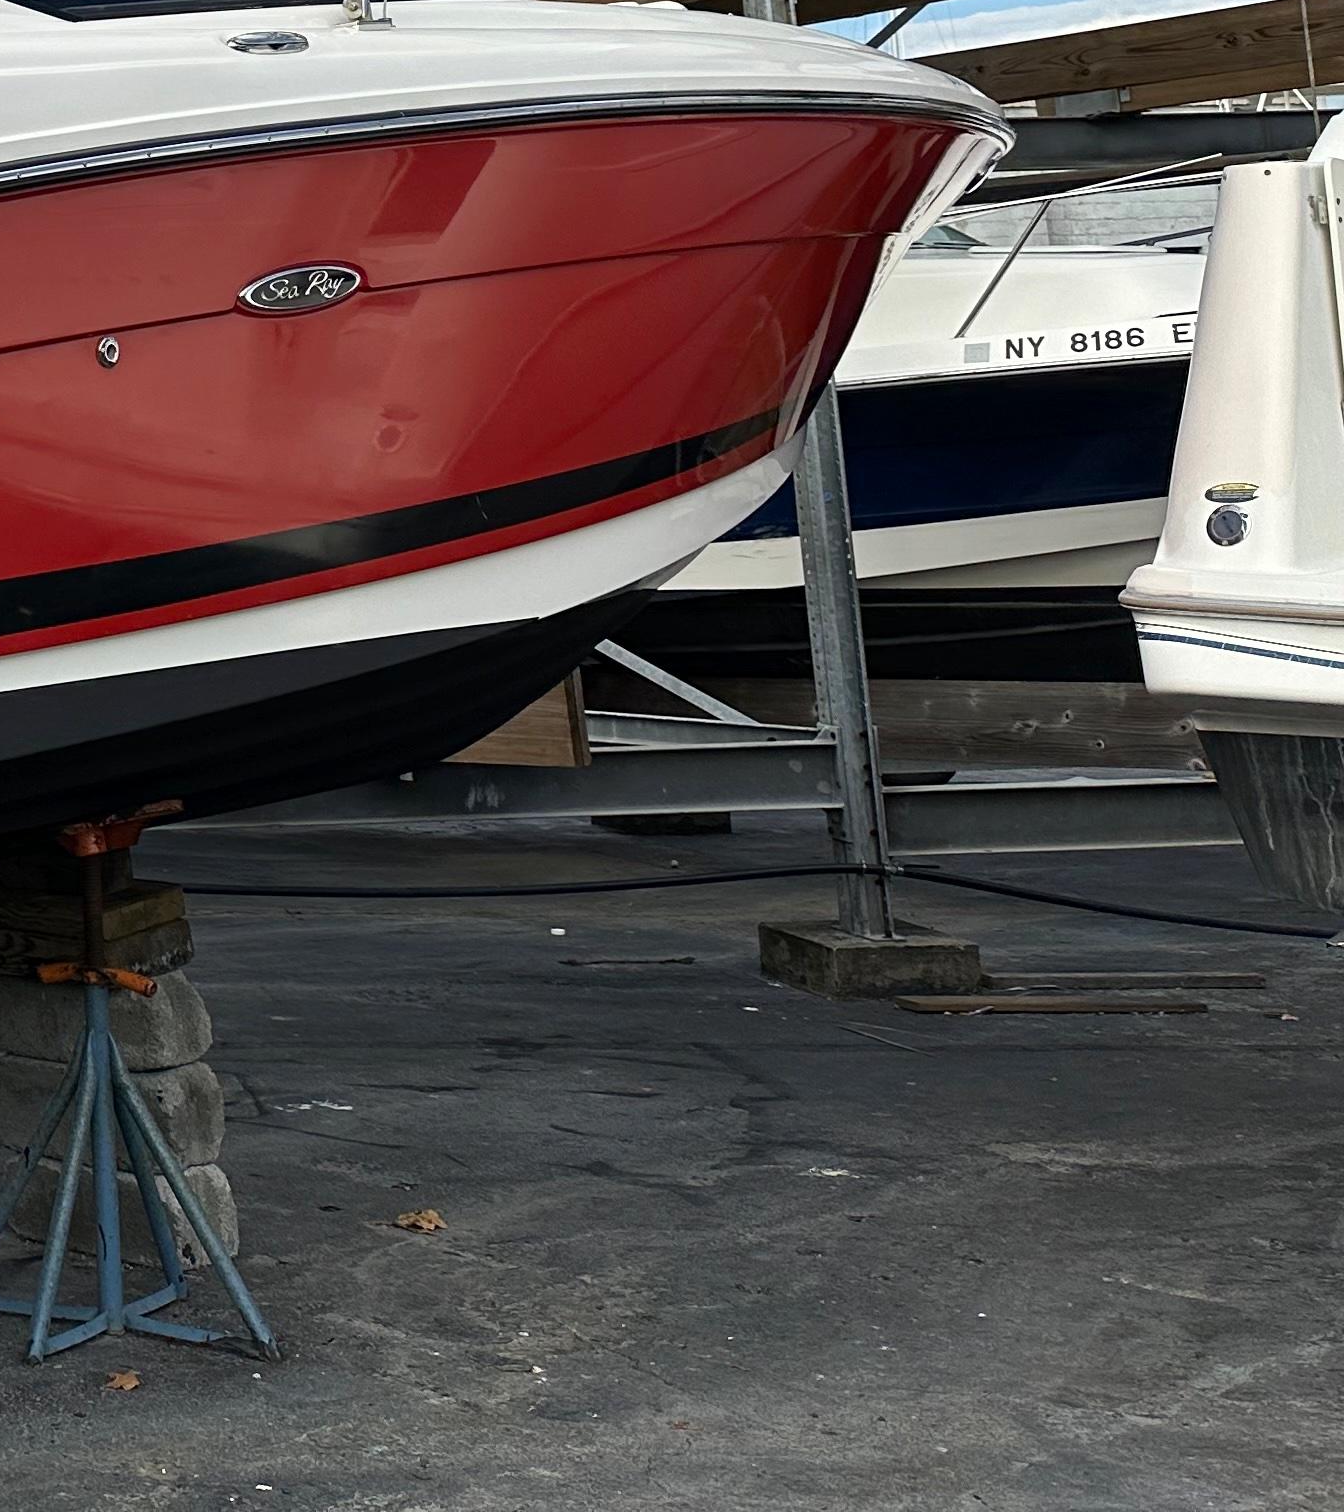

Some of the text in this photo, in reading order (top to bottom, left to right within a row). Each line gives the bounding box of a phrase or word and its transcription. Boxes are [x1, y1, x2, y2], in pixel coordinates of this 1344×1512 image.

[261, 270, 345, 302] Sea Ray
[1005, 321, 1198, 360] NY 8186 E
